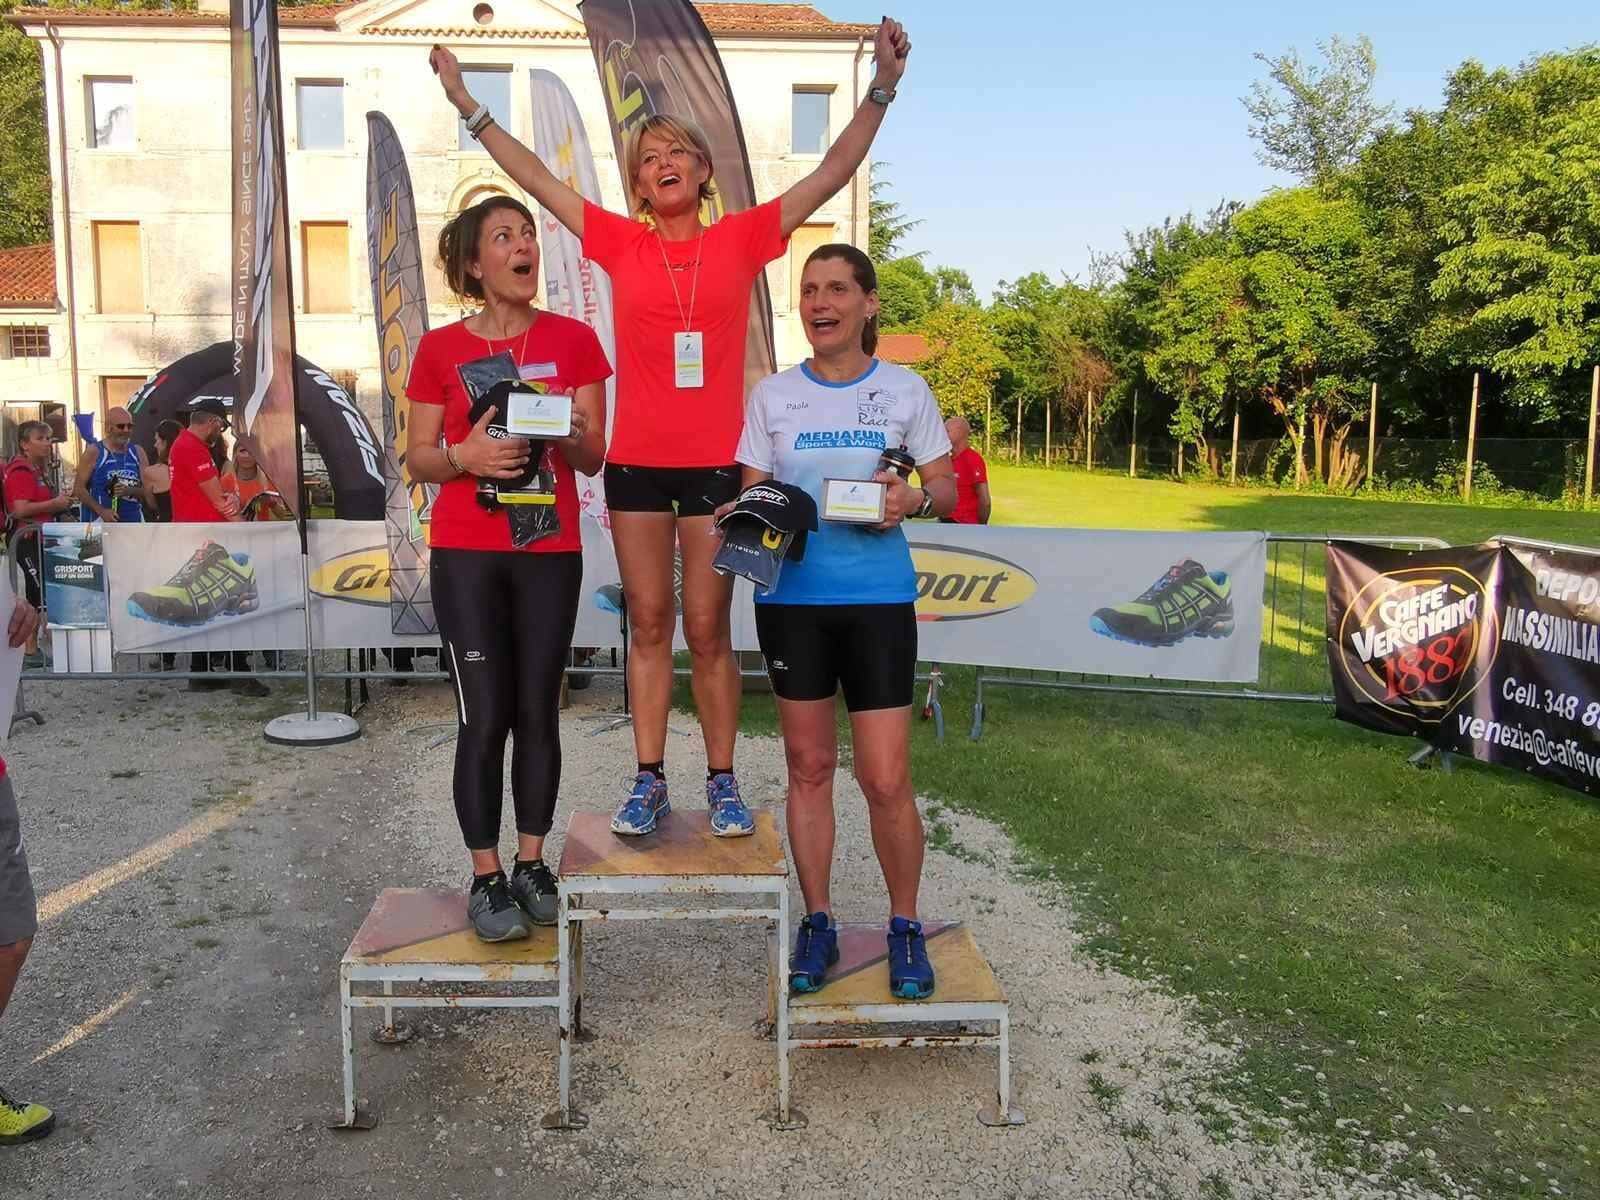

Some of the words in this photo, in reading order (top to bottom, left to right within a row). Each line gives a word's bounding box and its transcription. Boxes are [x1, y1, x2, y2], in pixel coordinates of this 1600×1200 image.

[797, 430, 886, 443] MEDIAFUN
[795, 440, 833, 449] Sport
[850, 440, 885, 449] Work
[54, 564, 95, 573] GRISPORT
[1351, 593, 1478, 663] VERGNANO
[1502, 676, 1541, 709] Cell.
[1544, 689, 1579, 721] 348
